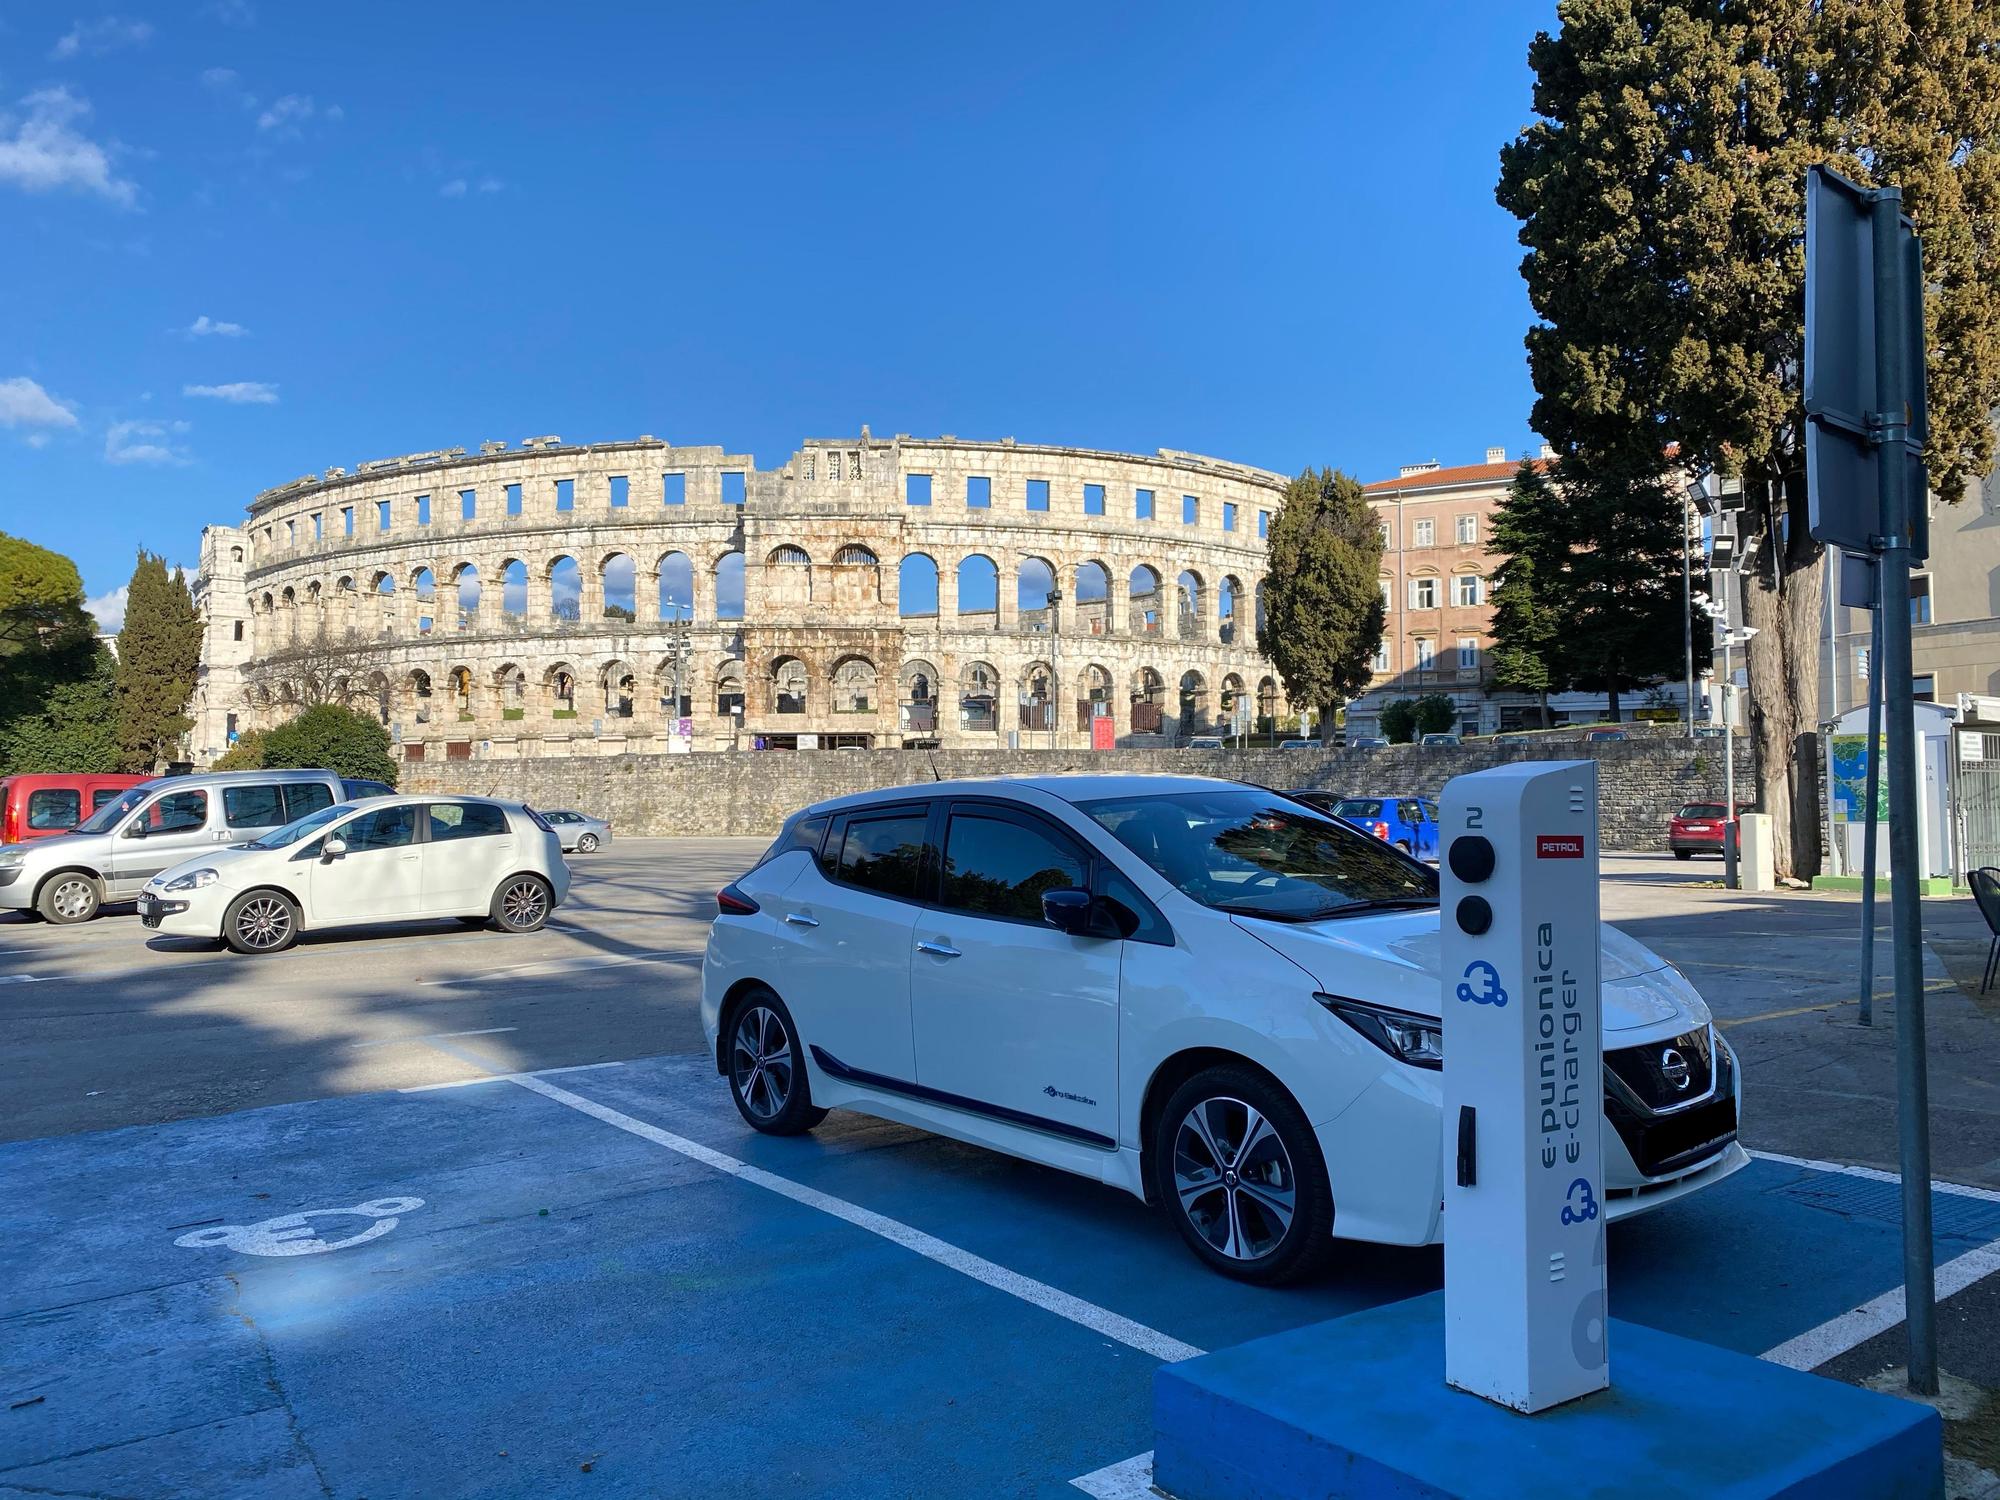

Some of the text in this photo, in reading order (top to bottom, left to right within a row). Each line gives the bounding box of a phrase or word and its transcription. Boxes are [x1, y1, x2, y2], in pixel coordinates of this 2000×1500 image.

[1466, 806, 1483, 829] 2
[1541, 842, 1580, 852] PETROL
[1533, 922, 1561, 1169] e-punionica
[1560, 969, 1582, 1164] e-charger
